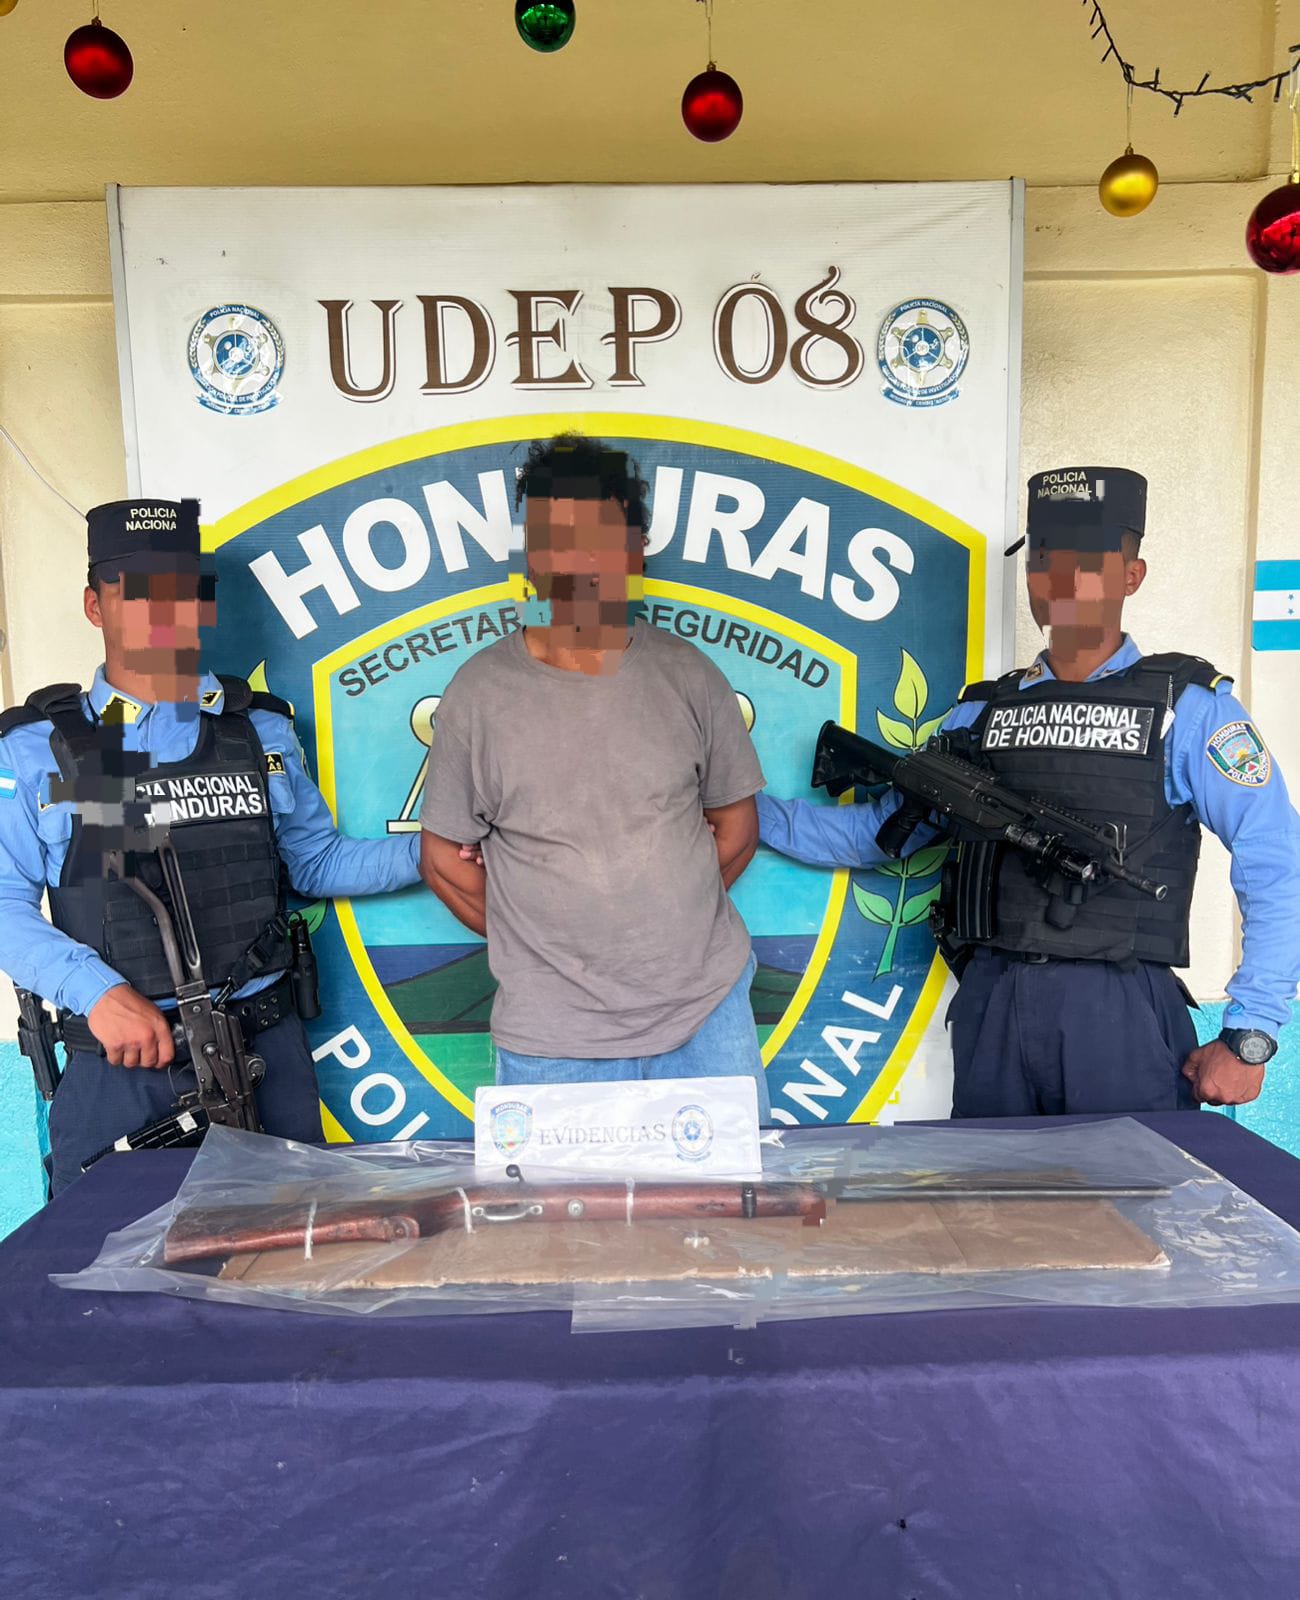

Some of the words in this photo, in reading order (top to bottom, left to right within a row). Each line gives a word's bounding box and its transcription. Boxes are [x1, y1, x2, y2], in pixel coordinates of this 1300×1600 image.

[319, 287, 682, 404] UDEP
[712, 266, 864, 390] 08
[1042, 471, 1087, 486] POLICIA
[1037, 483, 1092, 499] NACIONAL
[130, 507, 177, 519] POLICIA
[125, 520, 177, 531] NACIONA
[991, 705, 1047, 728] POLICIA
[1049, 704, 1141, 729] NACIONAL
[986, 728, 1012, 748] DE
[1015, 725, 1140, 751] HONDURAS
[168, 775, 258, 798] NACIONAL
[539, 1123, 666, 1145] EVIDENCIAS
